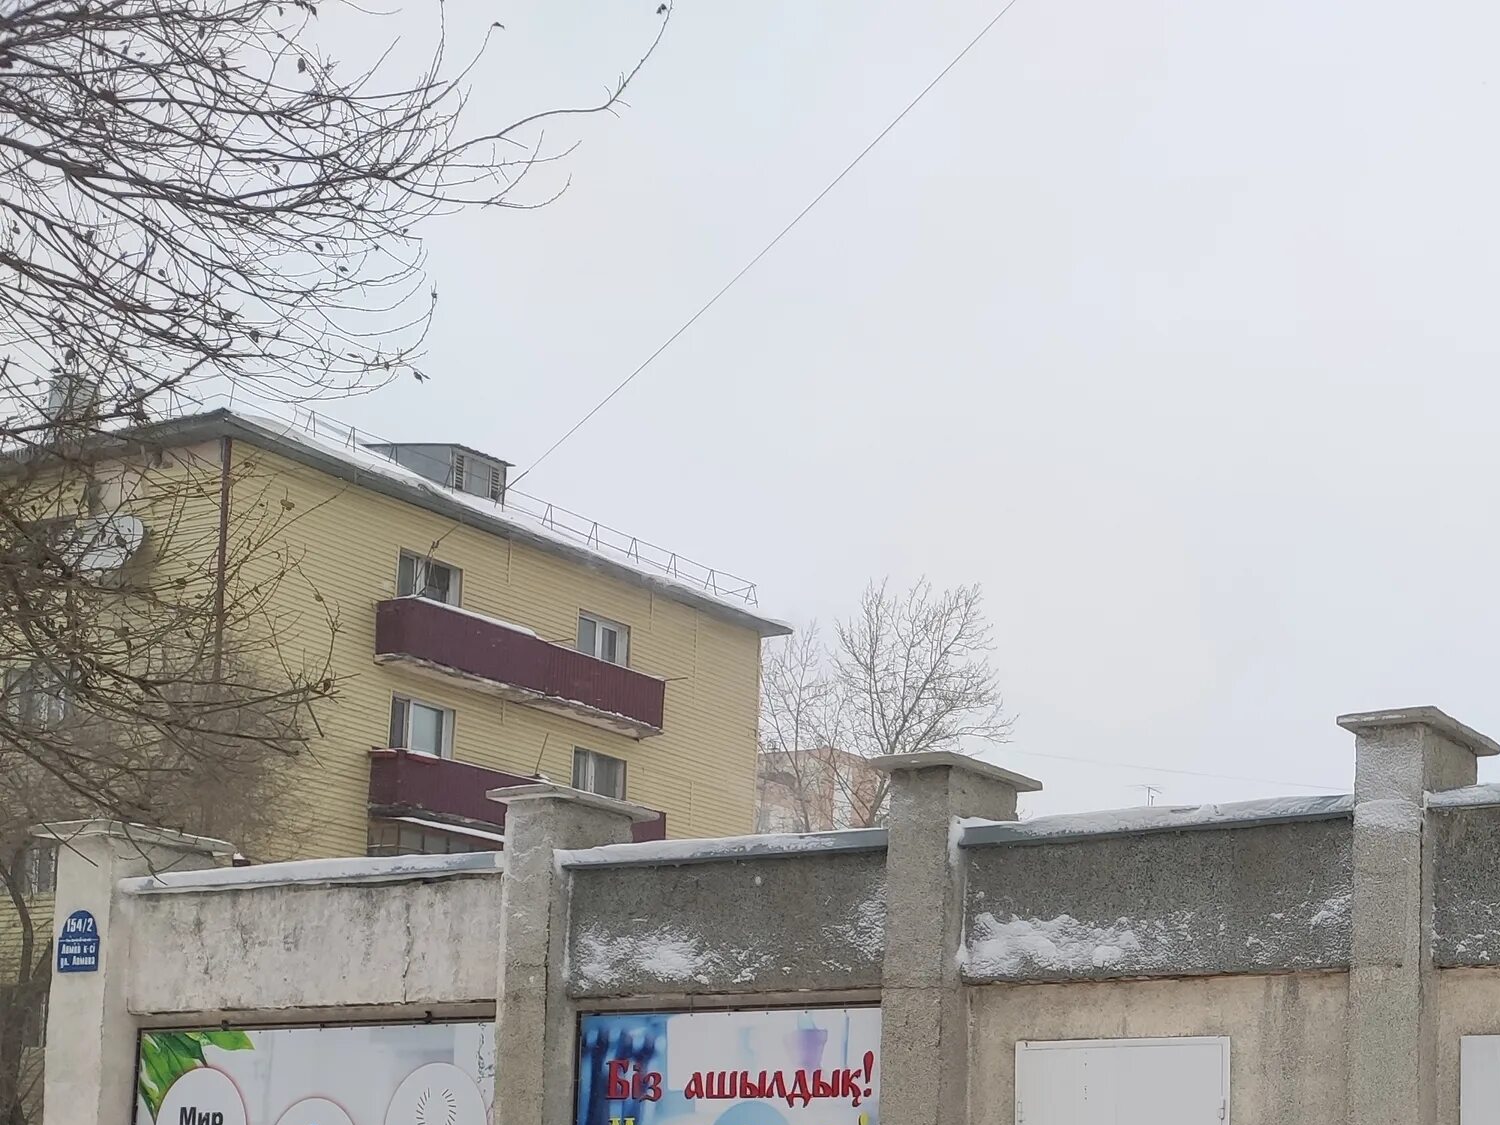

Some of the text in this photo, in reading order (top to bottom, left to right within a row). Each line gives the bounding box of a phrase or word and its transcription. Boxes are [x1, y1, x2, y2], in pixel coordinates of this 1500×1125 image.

[66, 917, 94, 933] 154/2
[606, 1051, 874, 1108] Біз ашылдық!
